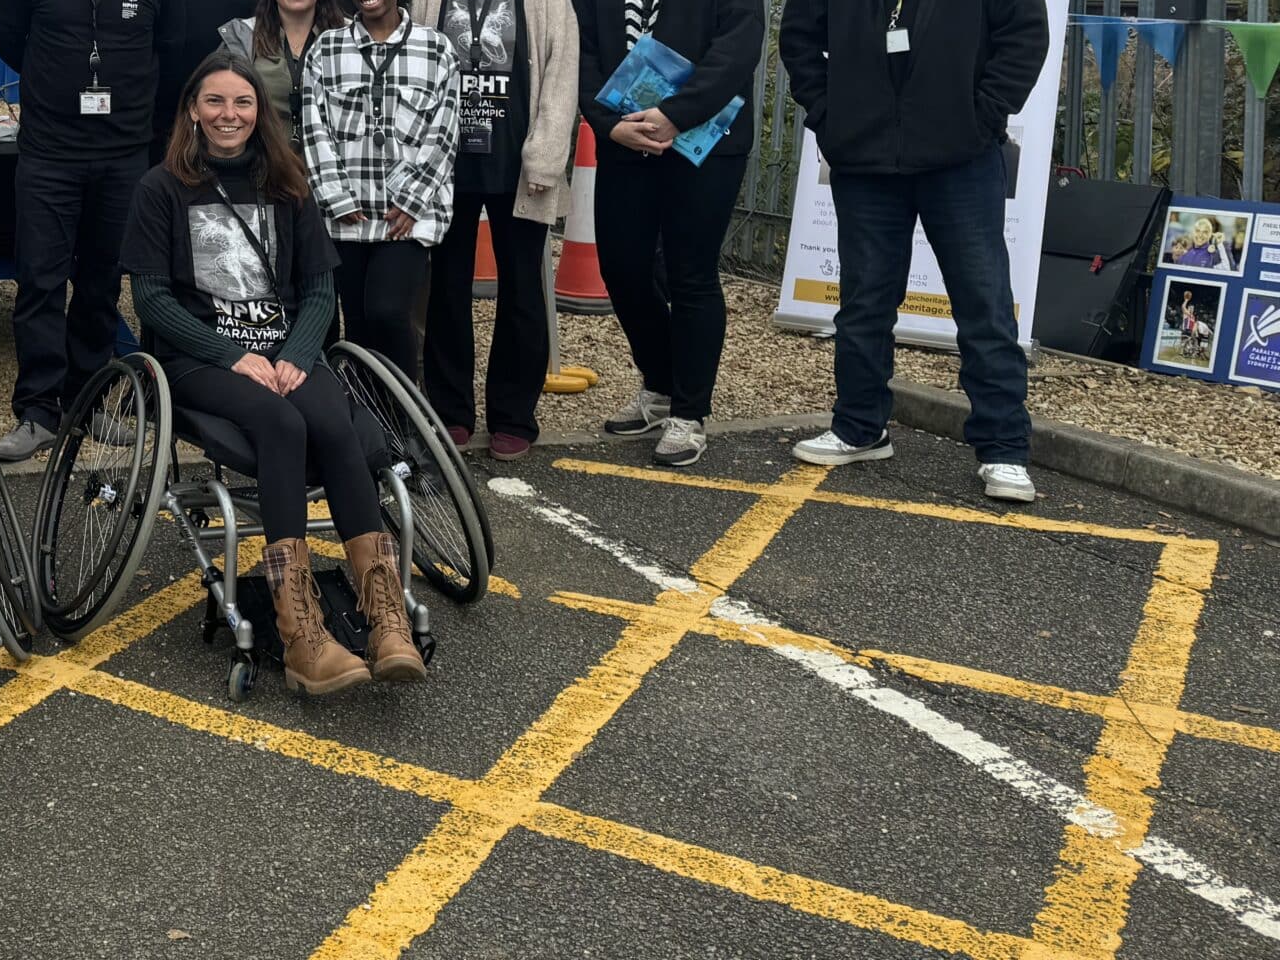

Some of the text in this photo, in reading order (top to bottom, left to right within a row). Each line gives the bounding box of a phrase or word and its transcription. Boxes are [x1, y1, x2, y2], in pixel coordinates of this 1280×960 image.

[460, 74, 510, 94] PHT
[460, 108, 505, 118] RALYMPIC
[800, 243, 836, 254] Thank you
[216, 326, 287, 341] PARALYMPIC
[1249, 352, 1277, 365] GAMES
